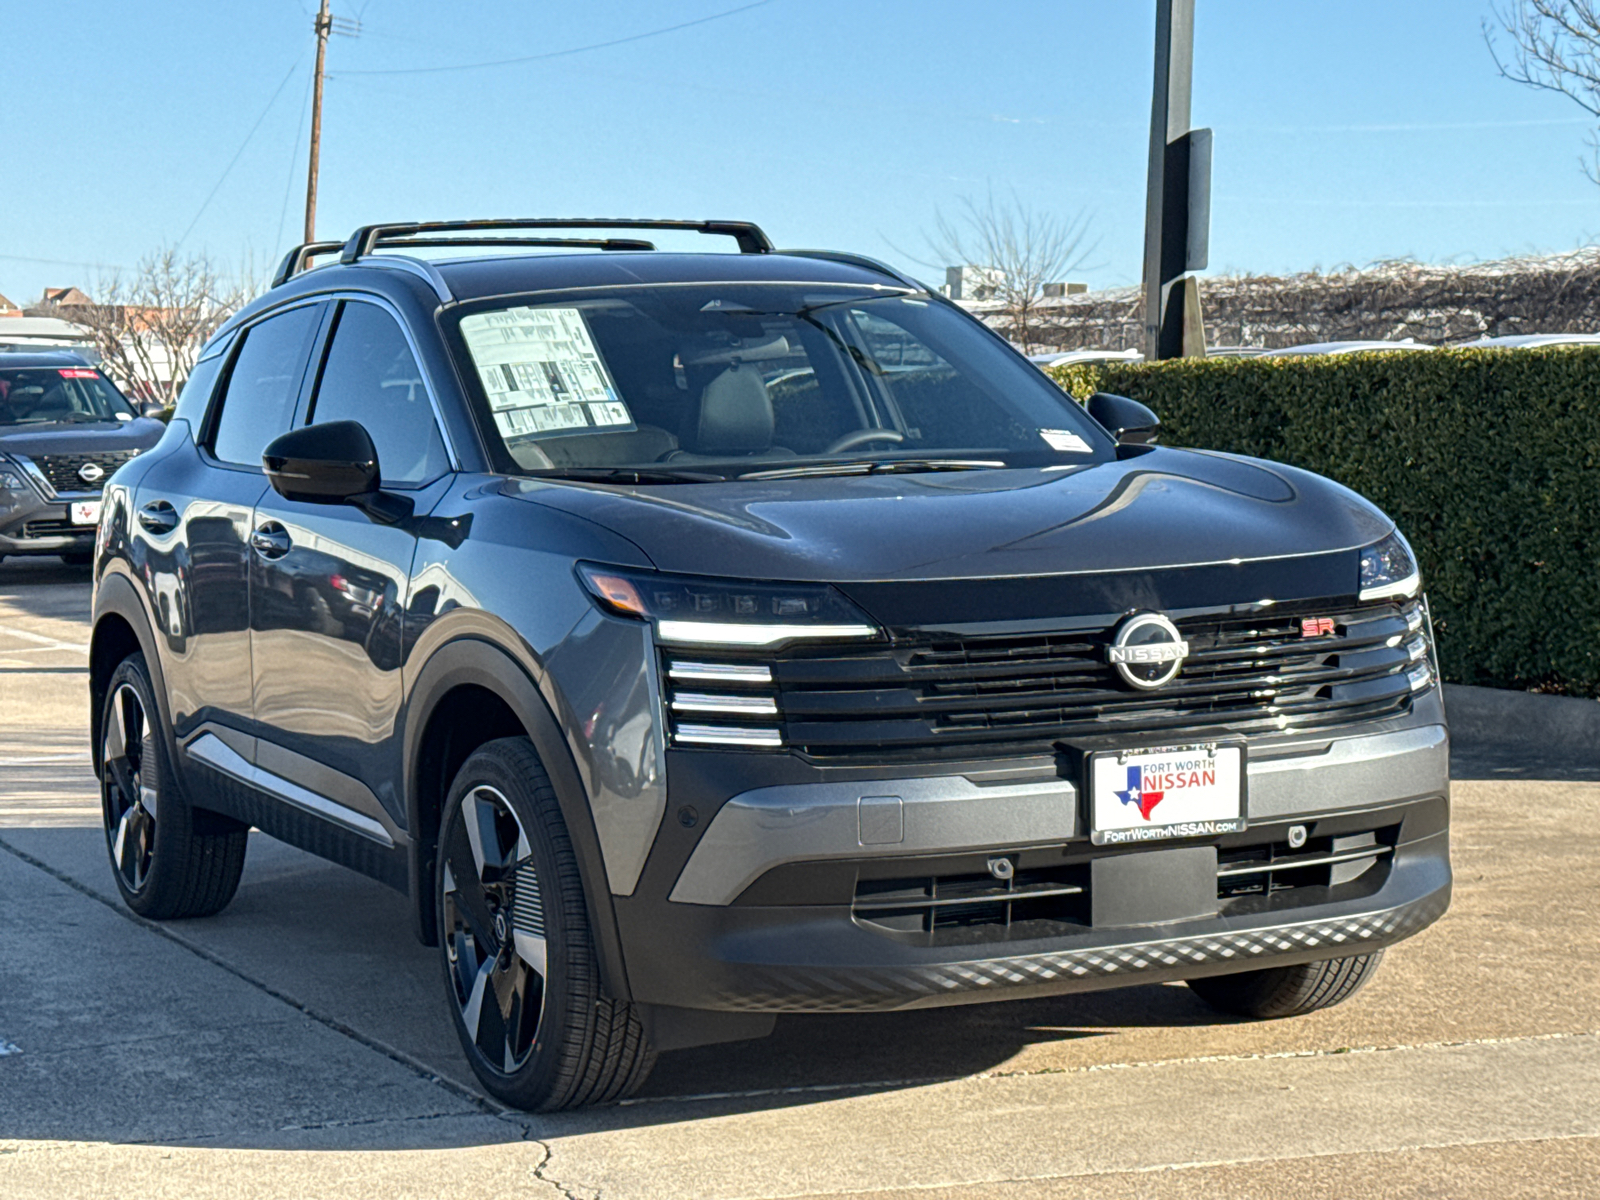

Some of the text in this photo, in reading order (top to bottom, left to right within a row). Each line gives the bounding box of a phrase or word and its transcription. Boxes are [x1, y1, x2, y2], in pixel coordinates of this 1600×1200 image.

[1302, 618, 1335, 637] SR
[1111, 646, 1185, 661] NISSAN
[1143, 759, 1215, 774] FORT WORTH
[1144, 770, 1215, 791] NISSAN
